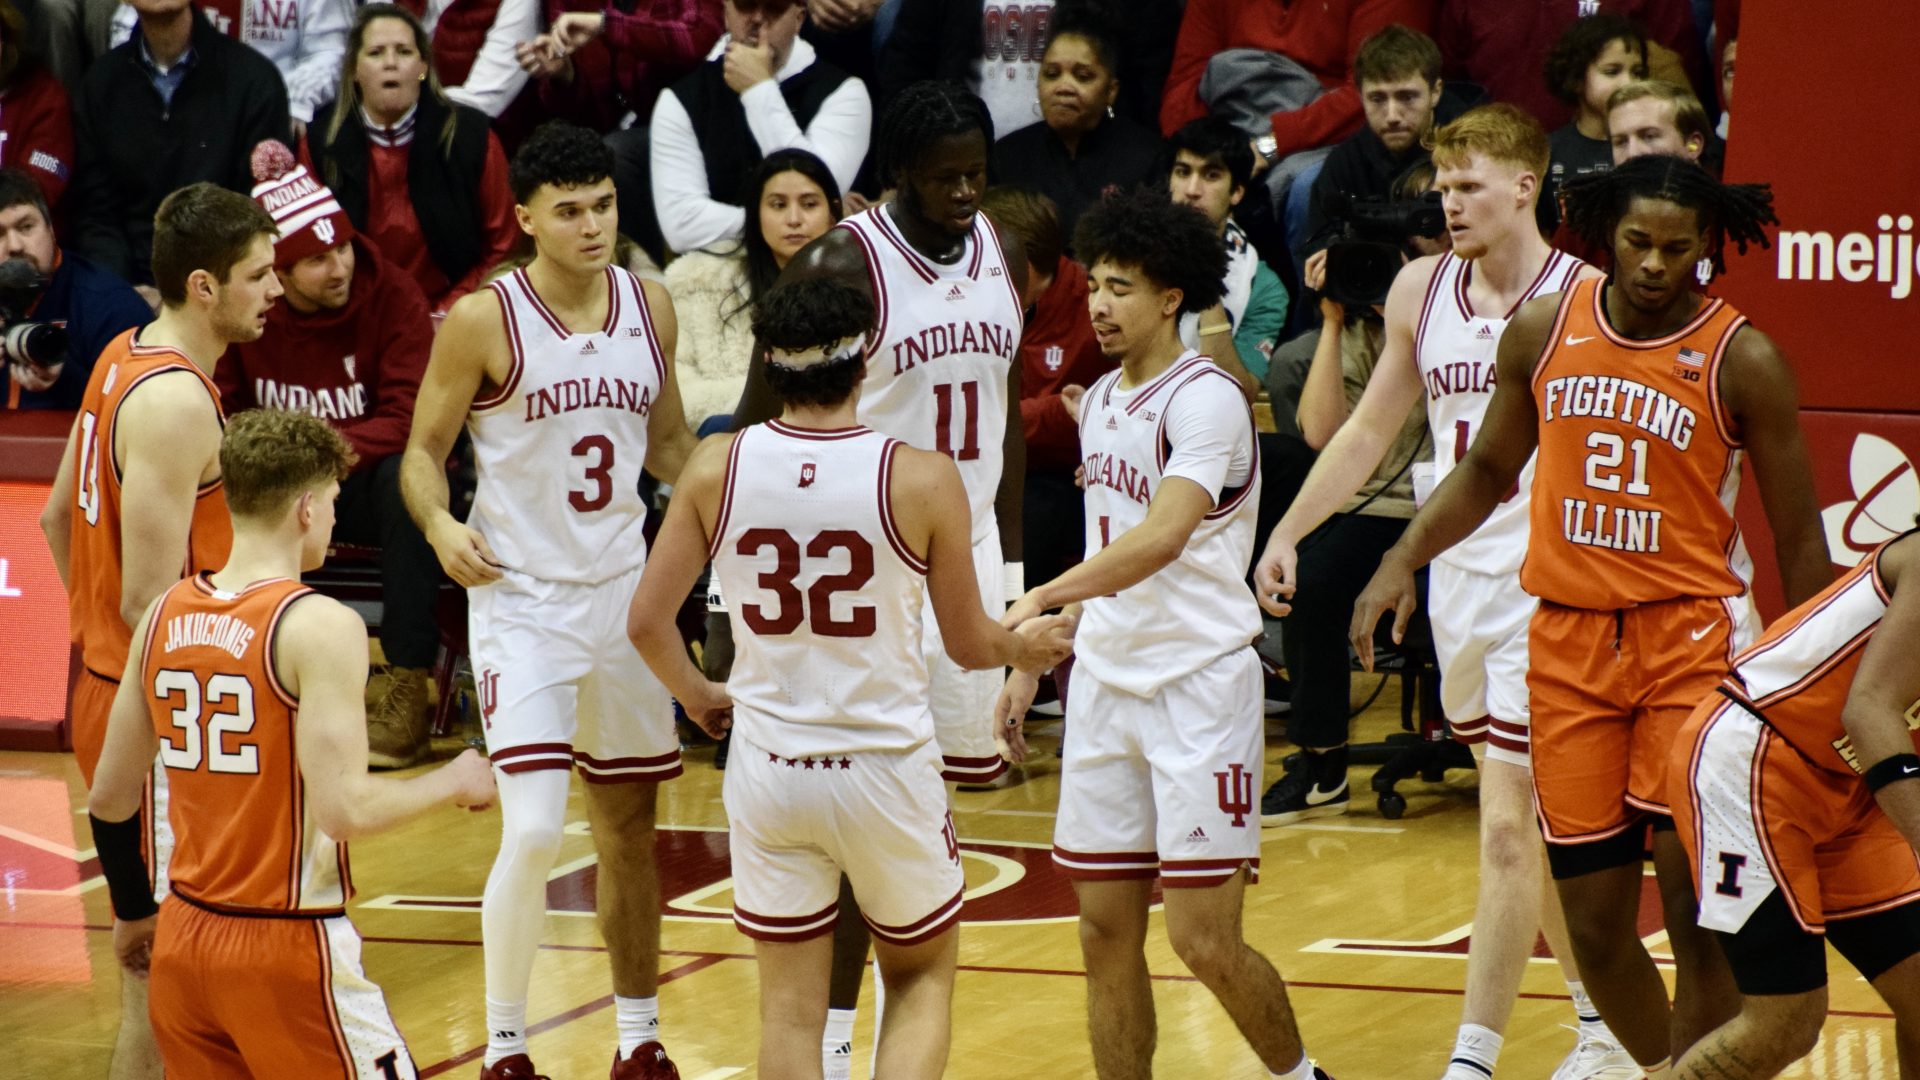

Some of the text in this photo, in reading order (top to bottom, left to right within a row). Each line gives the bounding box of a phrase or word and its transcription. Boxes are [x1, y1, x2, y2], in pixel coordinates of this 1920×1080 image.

[1778, 214, 1920, 299] meij
[893, 320, 1014, 376] INDIANA
[525, 377, 650, 422] INDIANA
[932, 380, 981, 461] 11
[1544, 375, 1697, 452] FIGHTING
[568, 434, 615, 512] 3
[1584, 431, 1651, 496] 21
[1562, 498, 1661, 553] ILLINI
[736, 528, 877, 638] 32
[164, 612, 256, 660] JAKUCIONIS
[153, 668, 260, 775] 32
